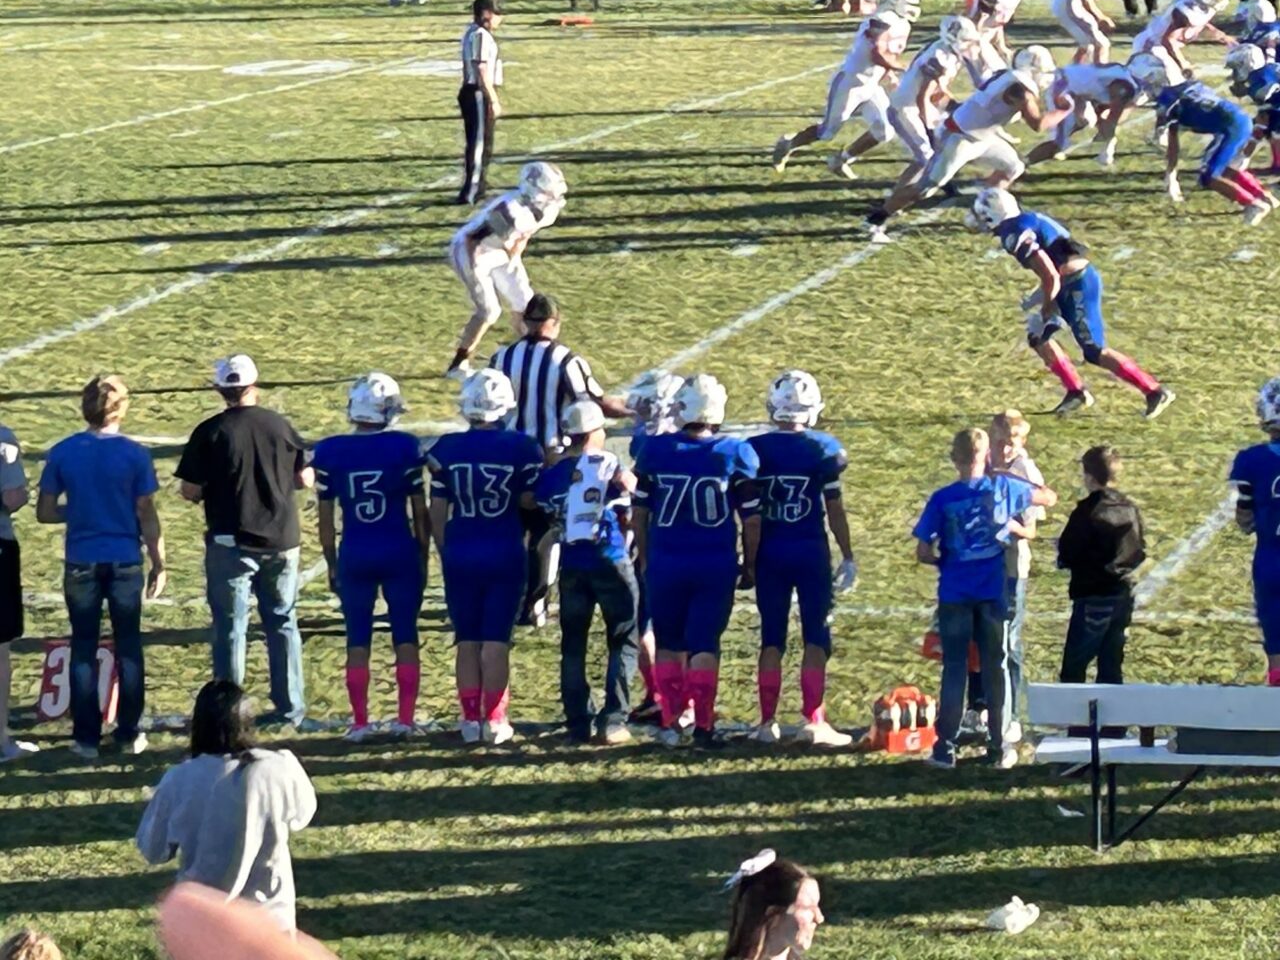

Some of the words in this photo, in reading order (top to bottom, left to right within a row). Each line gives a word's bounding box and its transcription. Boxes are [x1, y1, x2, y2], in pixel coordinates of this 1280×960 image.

[349, 470, 387, 523] 5
[449, 463, 515, 518] 13
[657, 474, 729, 527] 70
